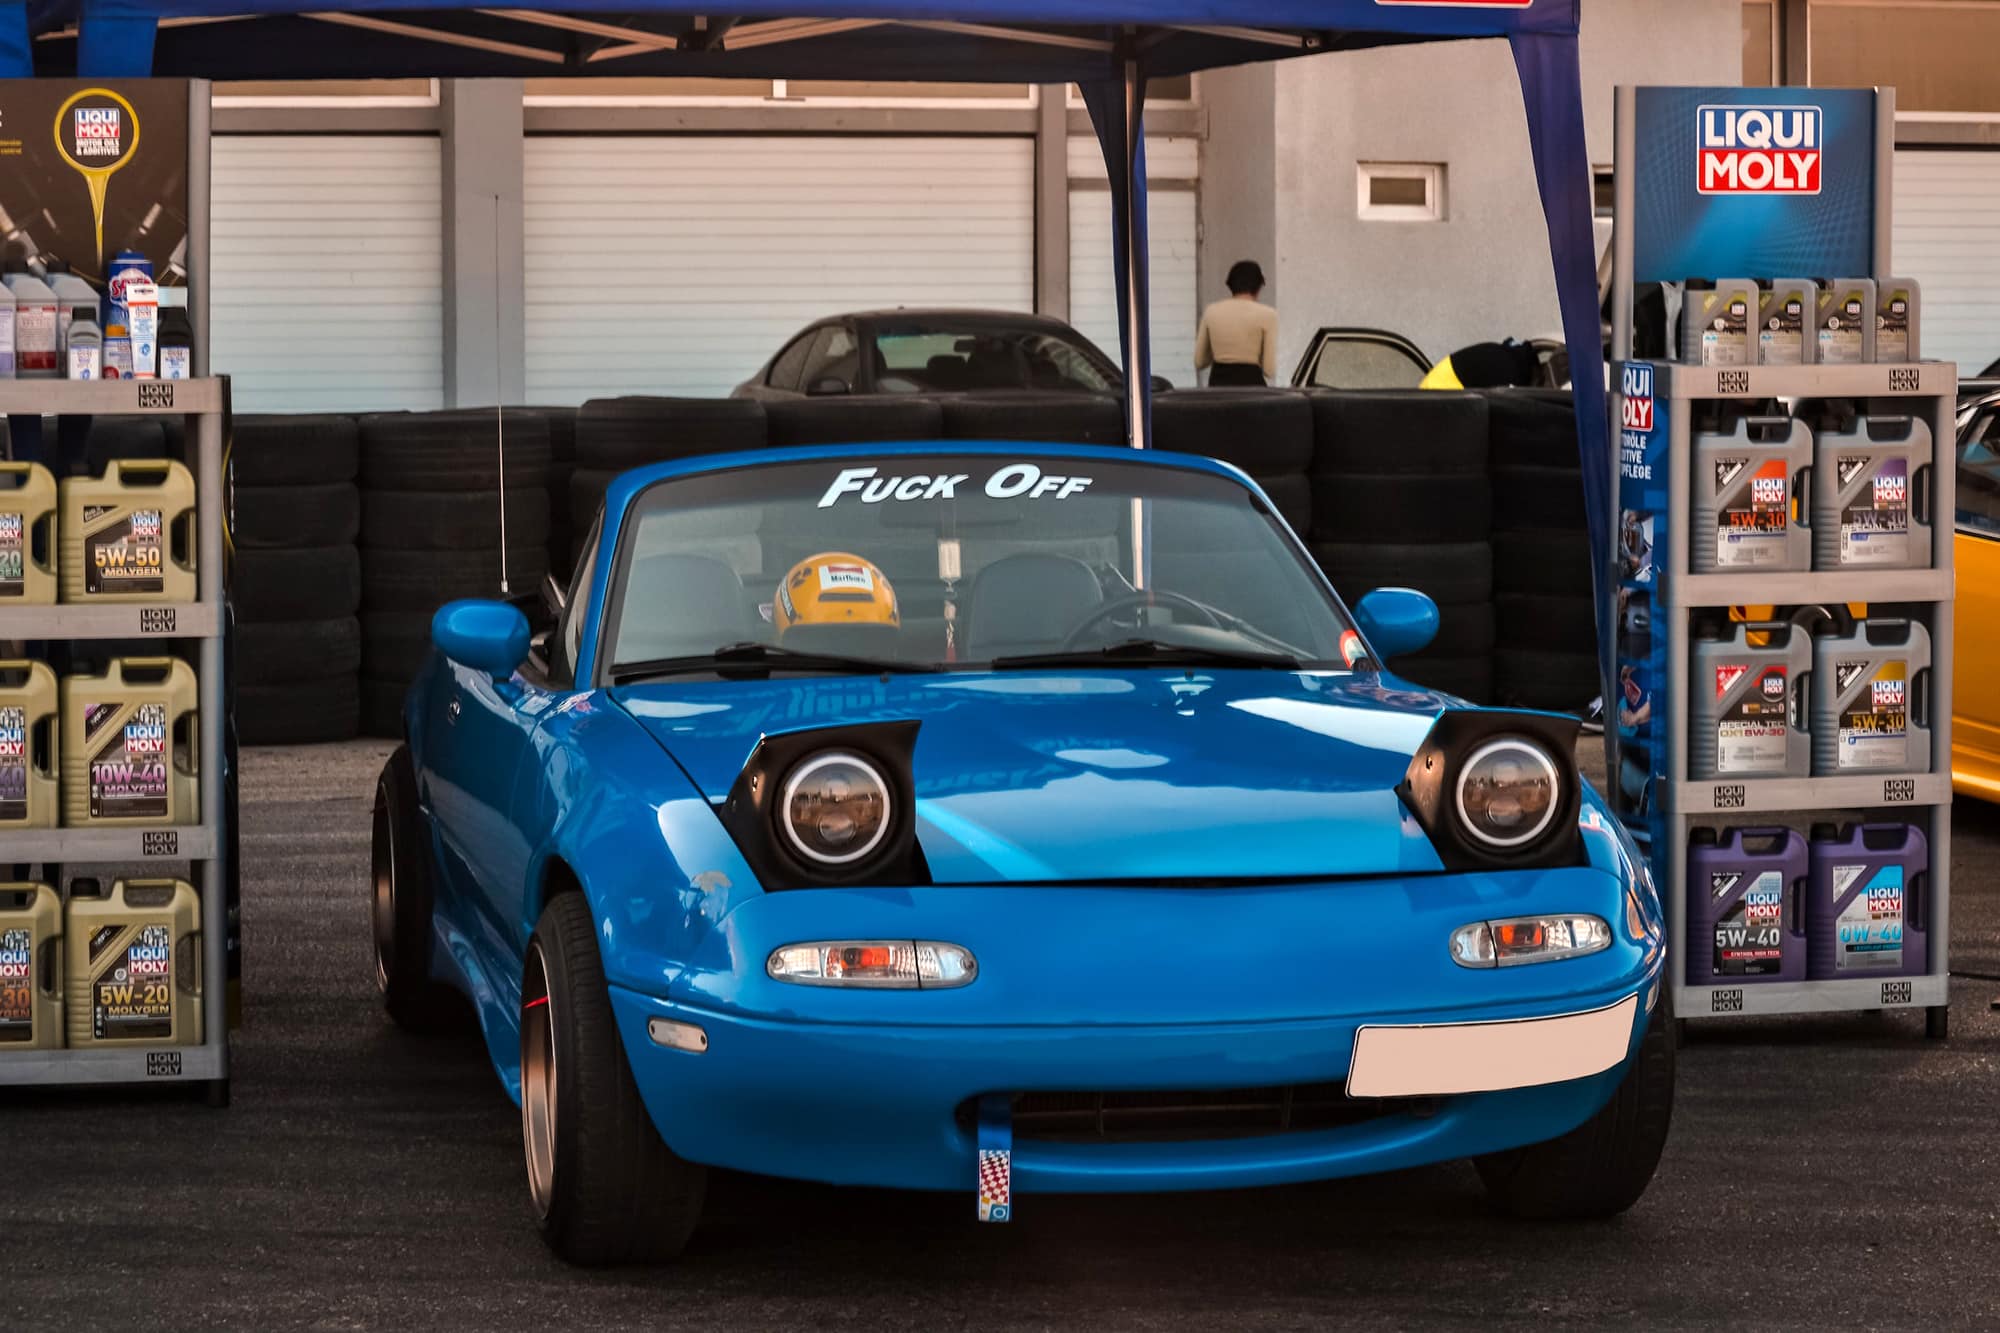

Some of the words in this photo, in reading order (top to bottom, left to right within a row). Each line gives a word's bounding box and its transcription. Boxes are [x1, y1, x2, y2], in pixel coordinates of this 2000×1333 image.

[77, 110, 117, 123] LIQUI
[77, 124, 118, 138] MOLY
[1704, 110, 1815, 149] LIQUI
[1704, 152, 1818, 190] MOLY
[1718, 371, 1748, 382] LIQUI
[1890, 369, 1919, 380] LIQUI
[1623, 368, 1650, 397] QUI
[1718, 382, 1749, 392] MOLY
[1890, 380, 1919, 390] MOLY
[140, 384, 172, 395] LIQUI
[140, 396, 173, 407] MOLY
[1622, 397, 1651, 427] OLY
[1753, 480, 1784, 490] LIQUI
[1875, 477, 1904, 489] LIQUI
[1754, 491, 1785, 502] MOLY
[1875, 489, 1905, 501] MOLY
[132, 517, 161, 527] LIQUI
[1730, 512, 1785, 527] 5W-30
[1853, 511, 1906, 525] 5W-30
[133, 526, 160, 536] MOLY
[95, 547, 161, 568] 5W-50
[105, 567, 161, 577] MOLYGEN
[142, 608, 175, 620] LIQUI
[142, 620, 175, 632] MOLY
[1764, 686, 1784, 694] MOLY
[1875, 681, 1903, 692] LIQUI
[1875, 693, 1904, 704] MOLY
[1720, 720, 1762, 728] SPECIAL
[1766, 720, 1785, 728] TEC
[1852, 714, 1904, 729] 5W-30
[0, 729, 22, 742] QUI
[127, 727, 162, 739] LIQUI
[0, 743, 22, 755] OLY
[127, 740, 164, 752] MOLY
[92, 763, 166, 785] 10W-40
[104, 784, 166, 794] MOLYGEN
[1715, 787, 1744, 796] LIQUI
[1885, 781, 1913, 791] LIQUI
[1885, 791, 1914, 801] MOLY
[1715, 797, 1745, 807] MOLY
[144, 832, 177, 844] LIQUI
[144, 844, 178, 855] MOLY
[1747, 893, 1779, 905] LIQUI
[1869, 888, 1899, 899] LIQUI
[1869, 899, 1901, 911] MOLY
[1747, 906, 1779, 918] MOLY
[1716, 928, 1780, 947] 5W-40
[1840, 924, 1902, 943] 0W-40
[131, 948, 166, 960] LIQUI
[131, 961, 166, 973] MOLY
[1882, 983, 1911, 992] LIQUI
[100, 985, 169, 1005] 5W-20
[1713, 991, 1742, 1000] LIQUI
[1883, 993, 1911, 1002] MOLY
[108, 1006, 170, 1016] MOLYGEN
[1713, 1001, 1742, 1011] MOLY
[148, 1053, 180, 1064] LIQUI
[149, 1064, 181, 1075] MOLY
